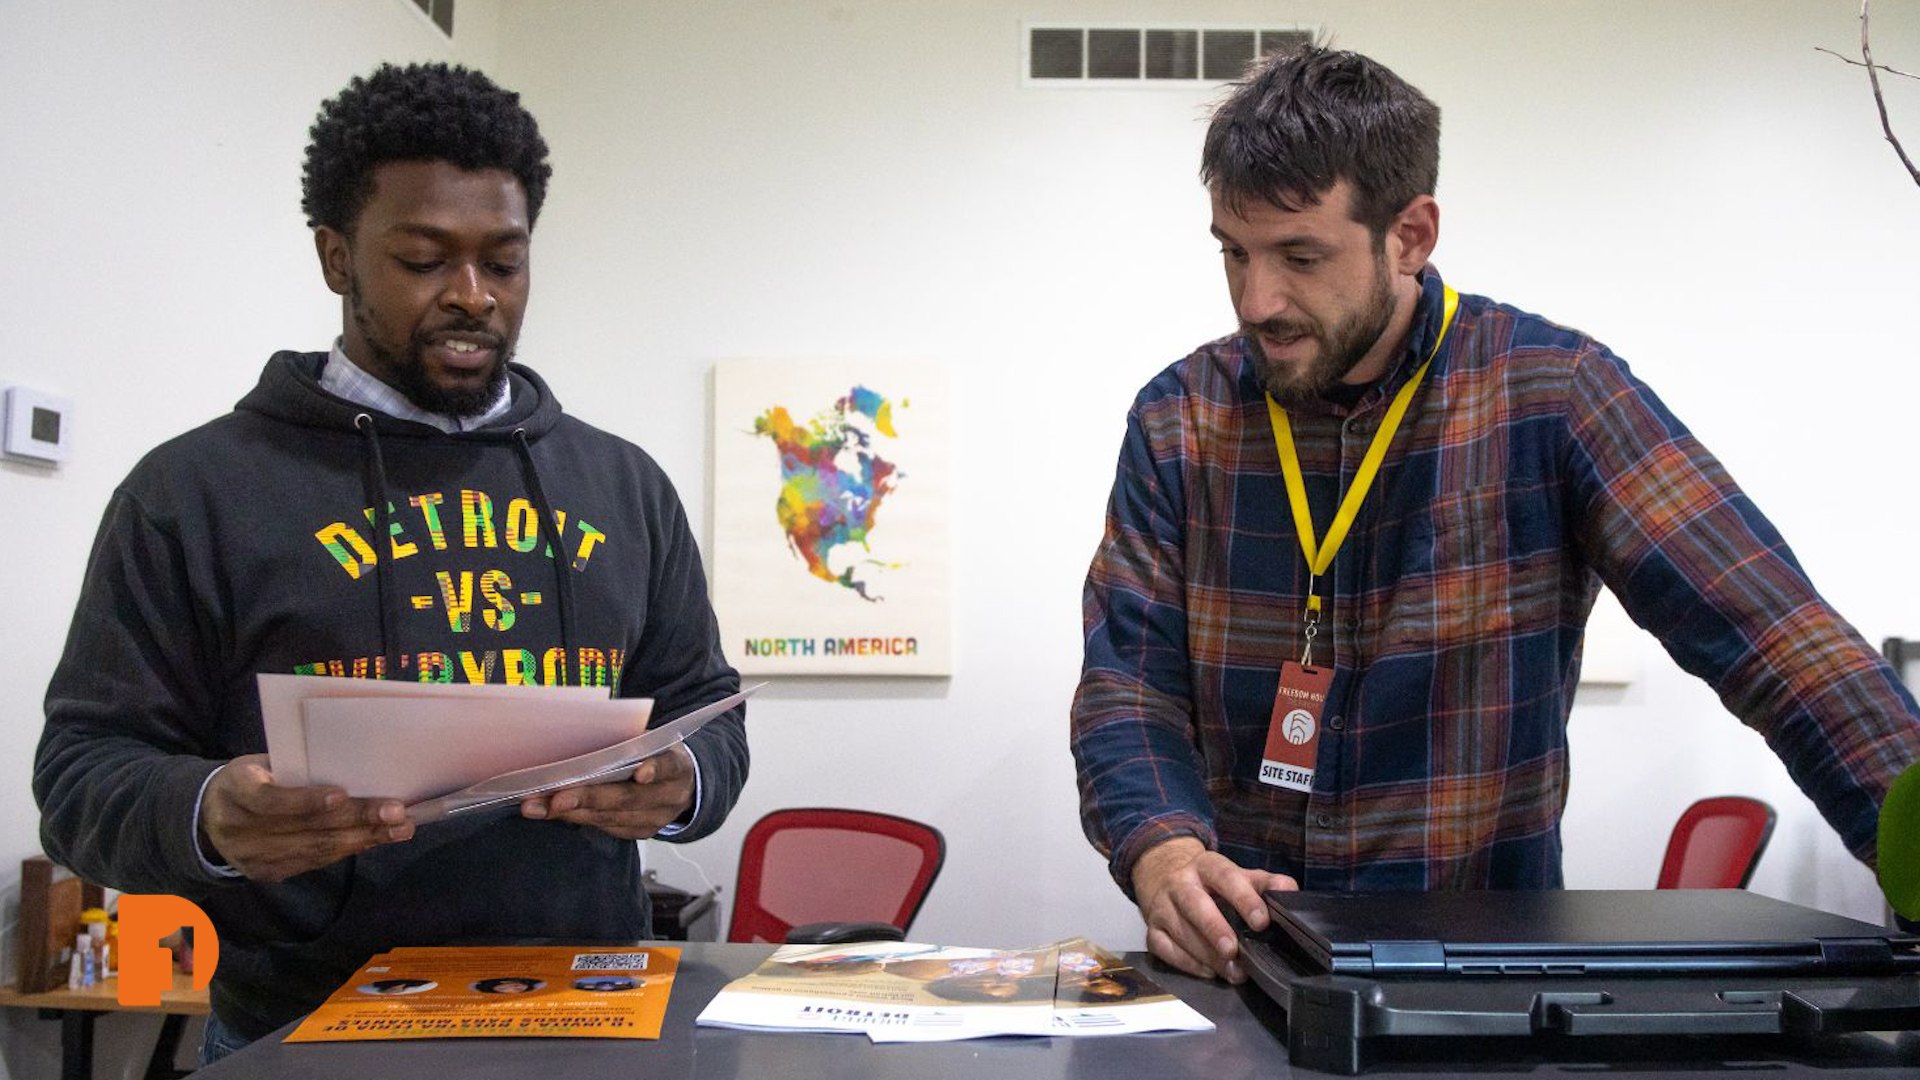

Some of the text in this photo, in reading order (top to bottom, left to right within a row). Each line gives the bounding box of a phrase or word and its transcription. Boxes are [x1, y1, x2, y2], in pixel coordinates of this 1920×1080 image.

[745, 637, 918, 656] NORTH AMERICA
[1262, 765, 1284, 780] SITE
